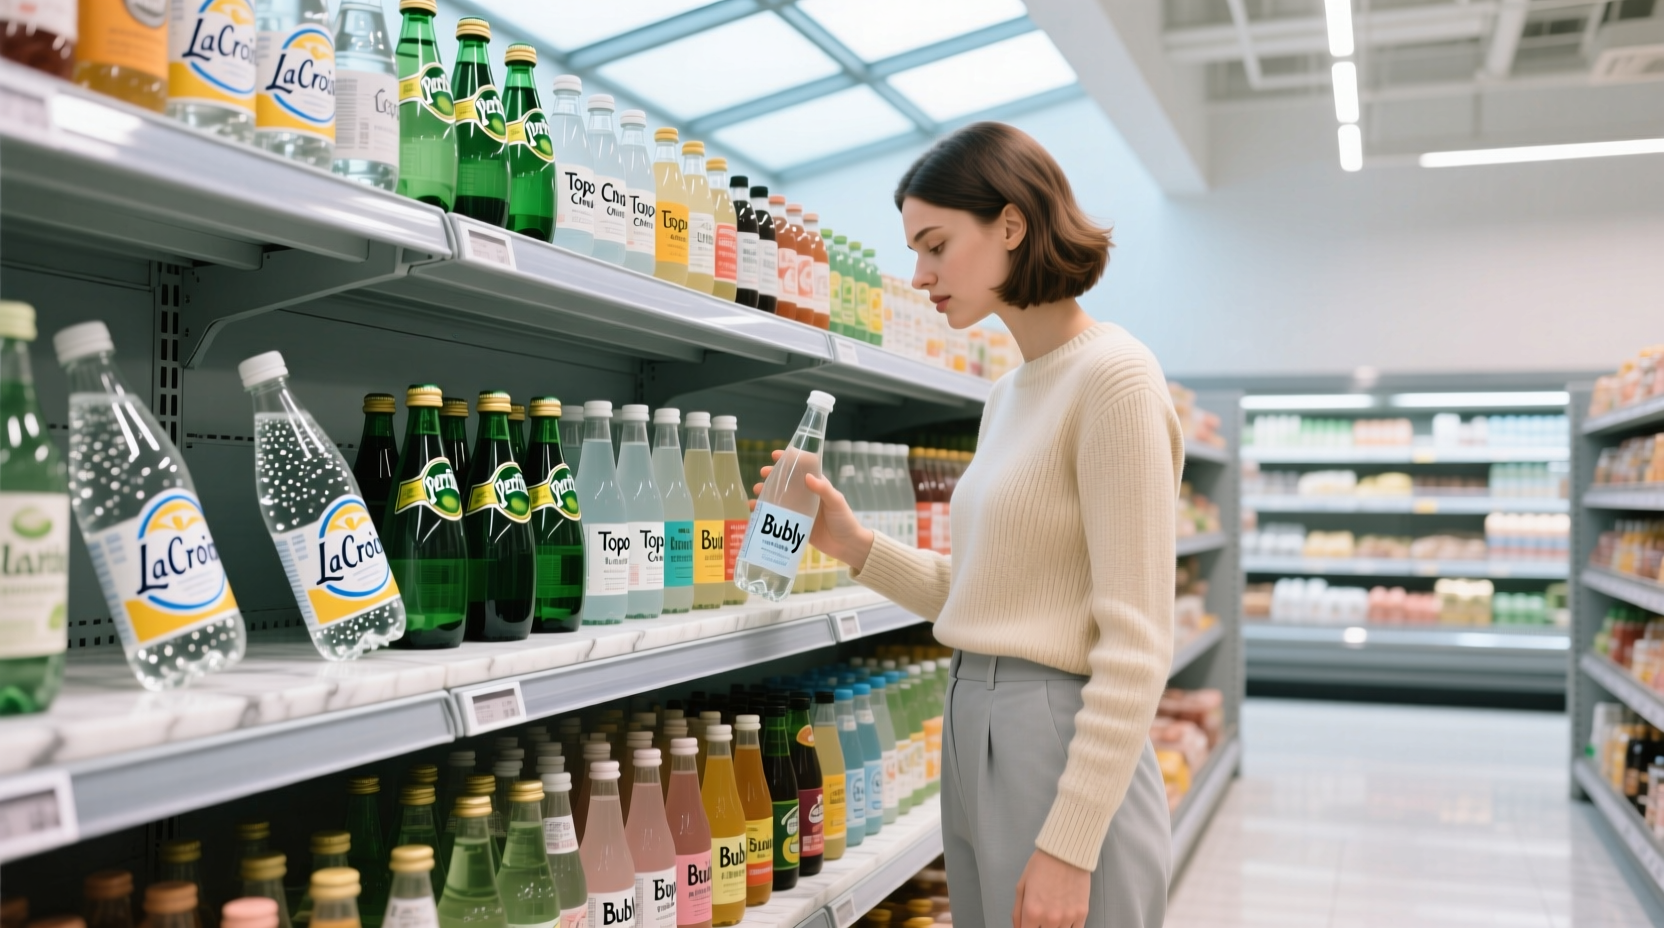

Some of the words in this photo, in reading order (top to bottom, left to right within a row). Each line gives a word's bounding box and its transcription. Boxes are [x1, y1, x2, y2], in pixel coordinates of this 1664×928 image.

[564, 171, 596, 198] Topo
[598, 531, 630, 557] Topo
[761, 513, 805, 554] Bubly
